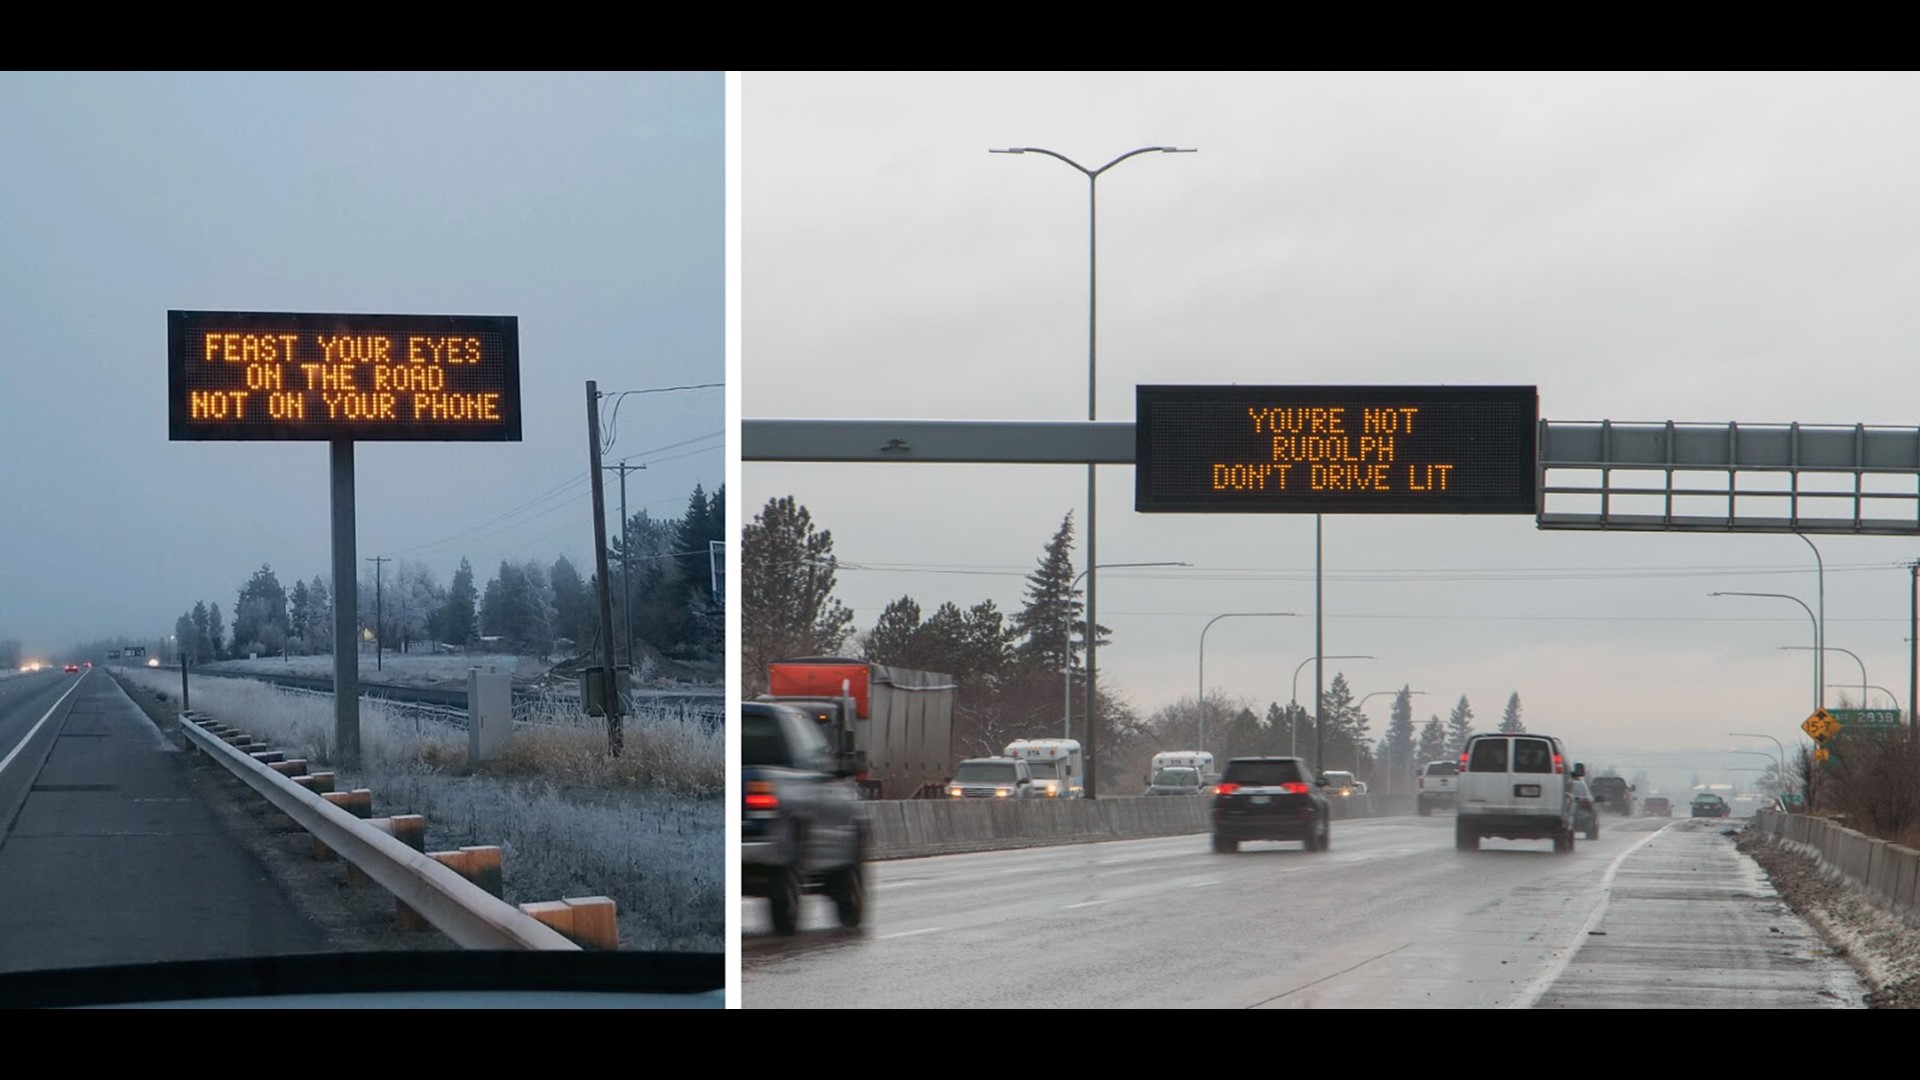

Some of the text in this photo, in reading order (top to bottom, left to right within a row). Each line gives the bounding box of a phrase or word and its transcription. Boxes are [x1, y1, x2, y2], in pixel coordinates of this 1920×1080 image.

[205, 333, 481, 364] FEAST YOUR EYES
[246, 363, 444, 391] ON THE ROAD
[190, 390, 500, 420] NOT ON YOUR PHONE
[1248, 407, 1418, 434] YOU'RE NOT
[1272, 436, 1394, 461] RUDOLPH
[1213, 463, 1453, 490] DON'T DRIVE LIT
